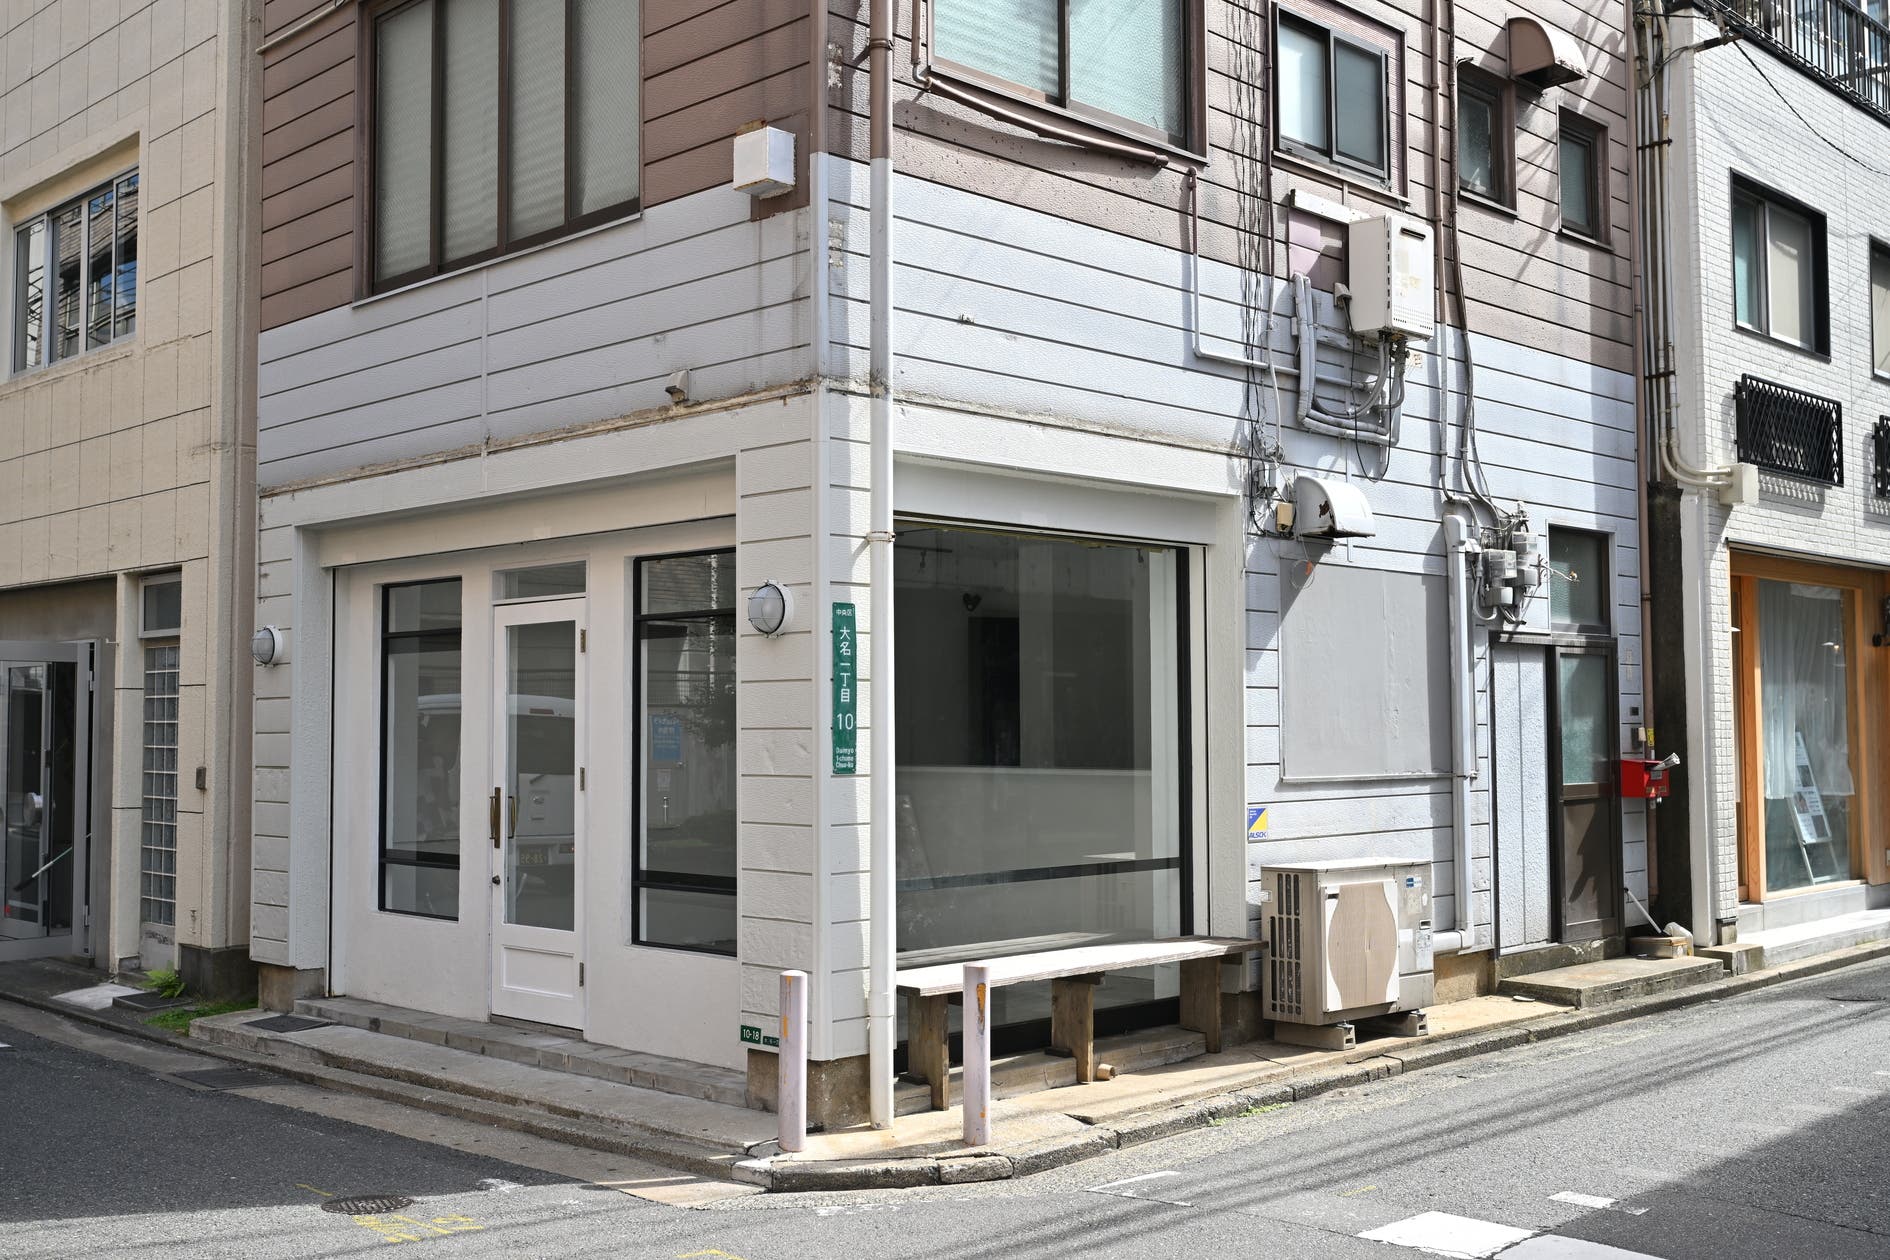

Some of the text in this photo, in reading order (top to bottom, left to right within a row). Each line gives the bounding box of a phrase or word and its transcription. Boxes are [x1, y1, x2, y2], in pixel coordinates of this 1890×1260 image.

[836, 608, 853, 617] 中央区
[839, 625, 851, 703] 大名一丁目
[836, 712, 854, 731] 10
[835, 746, 855, 756] Daimyo
[743, 1028, 760, 1041] 10-18
